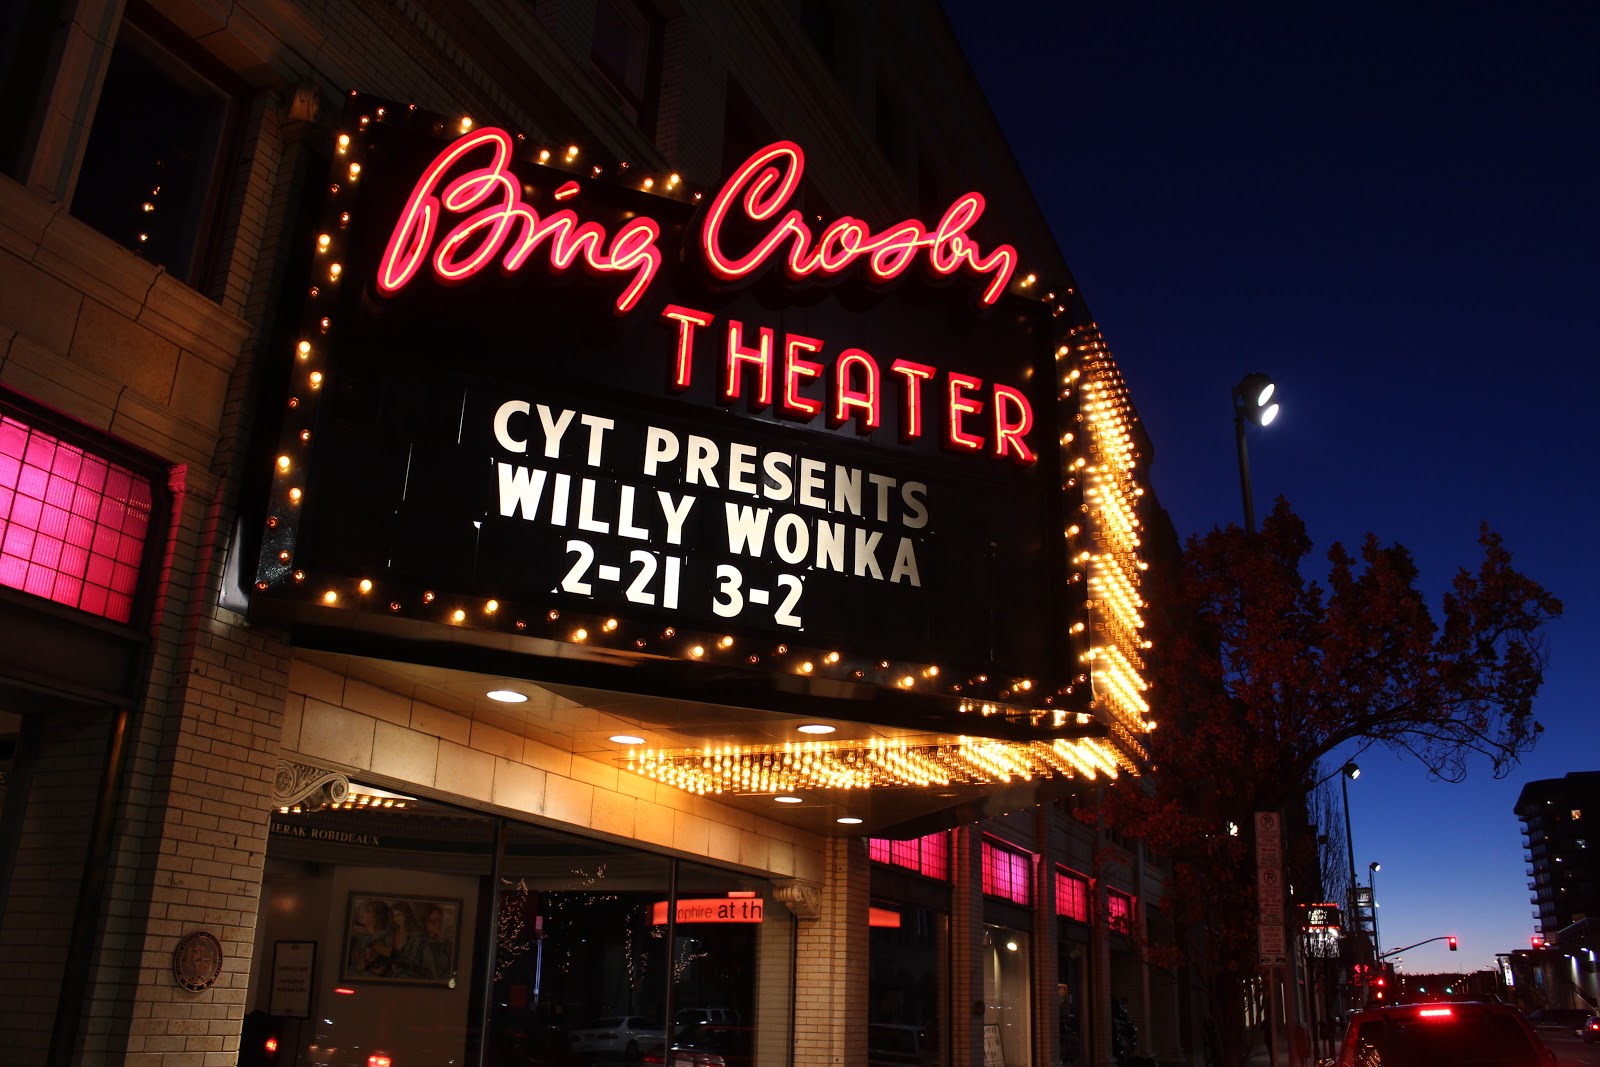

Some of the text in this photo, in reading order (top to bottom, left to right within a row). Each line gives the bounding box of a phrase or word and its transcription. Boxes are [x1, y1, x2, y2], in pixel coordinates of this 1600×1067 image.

[377, 127, 1018, 312] Bing Crosby
[661, 304, 1037, 464] THEATER
[493, 400, 929, 530] CYT PRESENTS
[497, 461, 922, 588] WILLY WONKA
[560, 539, 804, 628] 2-21 3-2
[311, 828, 380, 846] ROBIDEAUX
[717, 902, 736, 919] at
